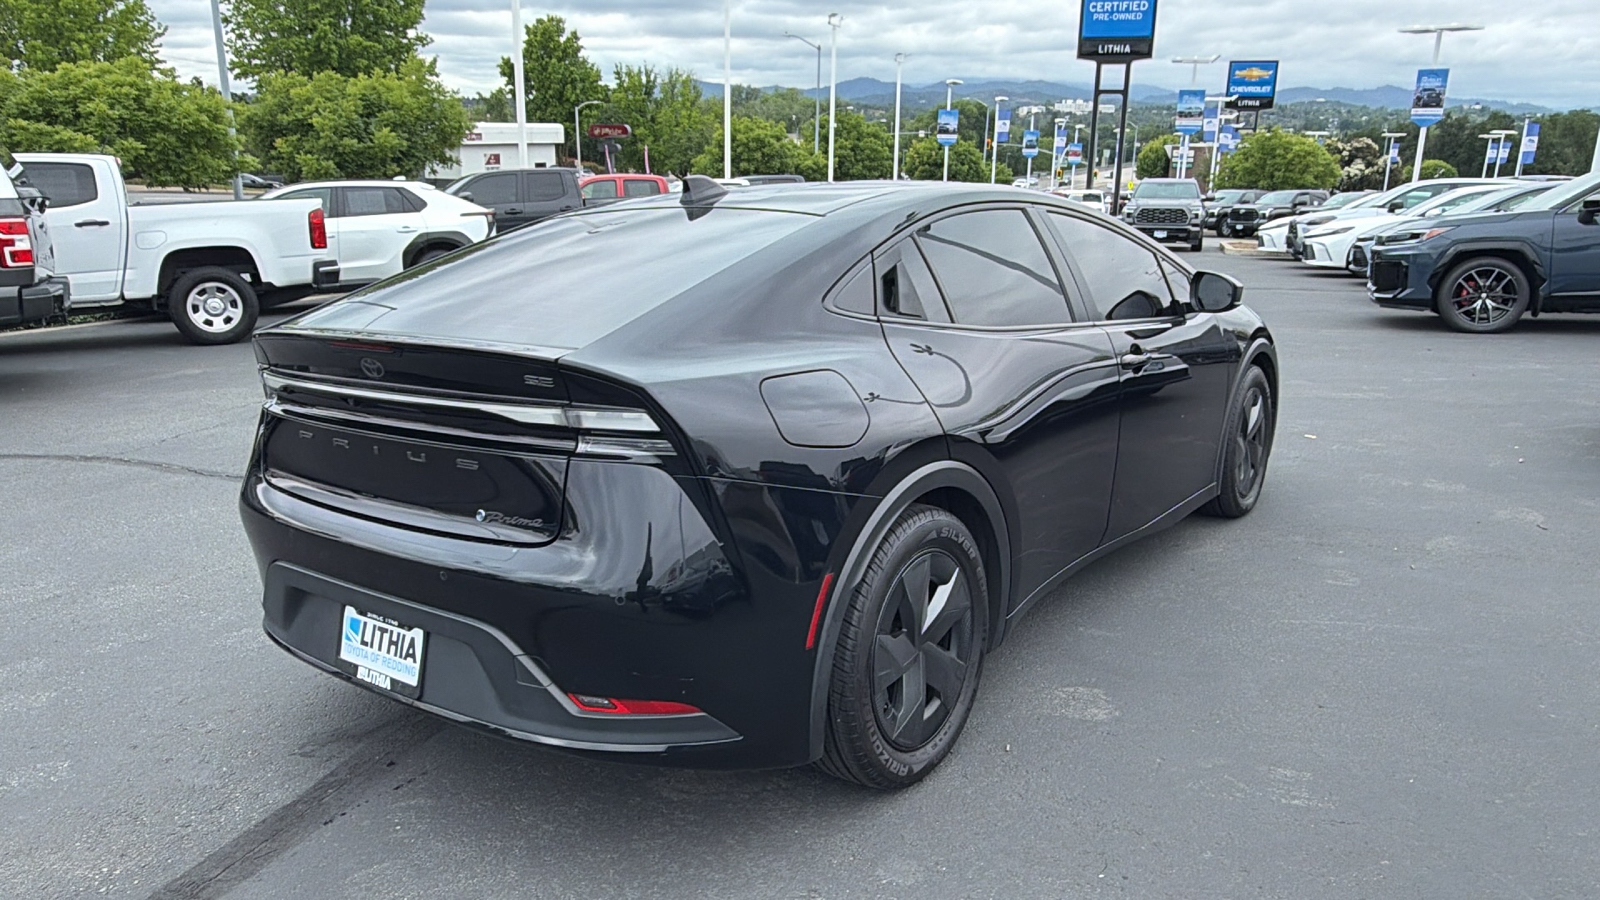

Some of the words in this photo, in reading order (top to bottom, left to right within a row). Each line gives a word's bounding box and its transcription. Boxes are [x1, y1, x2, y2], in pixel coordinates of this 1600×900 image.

[1089, 1, 1149, 12] CERTIFIED
[1093, 12, 1143, 21] PRE-OWNED
[1098, 44, 1131, 54] LITHIA
[1230, 85, 1272, 93] CHEVROLET
[523, 374, 555, 388] SE
[300, 430, 479, 470] PRIUS
[485, 511, 543, 527] Prime
[940, 526, 976, 560] SILVER
[360, 621, 417, 664] LITHIA
[344, 642, 369, 661] TOYOTA
[370, 652, 381, 664] OF
[381, 656, 416, 677] REDDING
[364, 667, 391, 690] LITHIA
